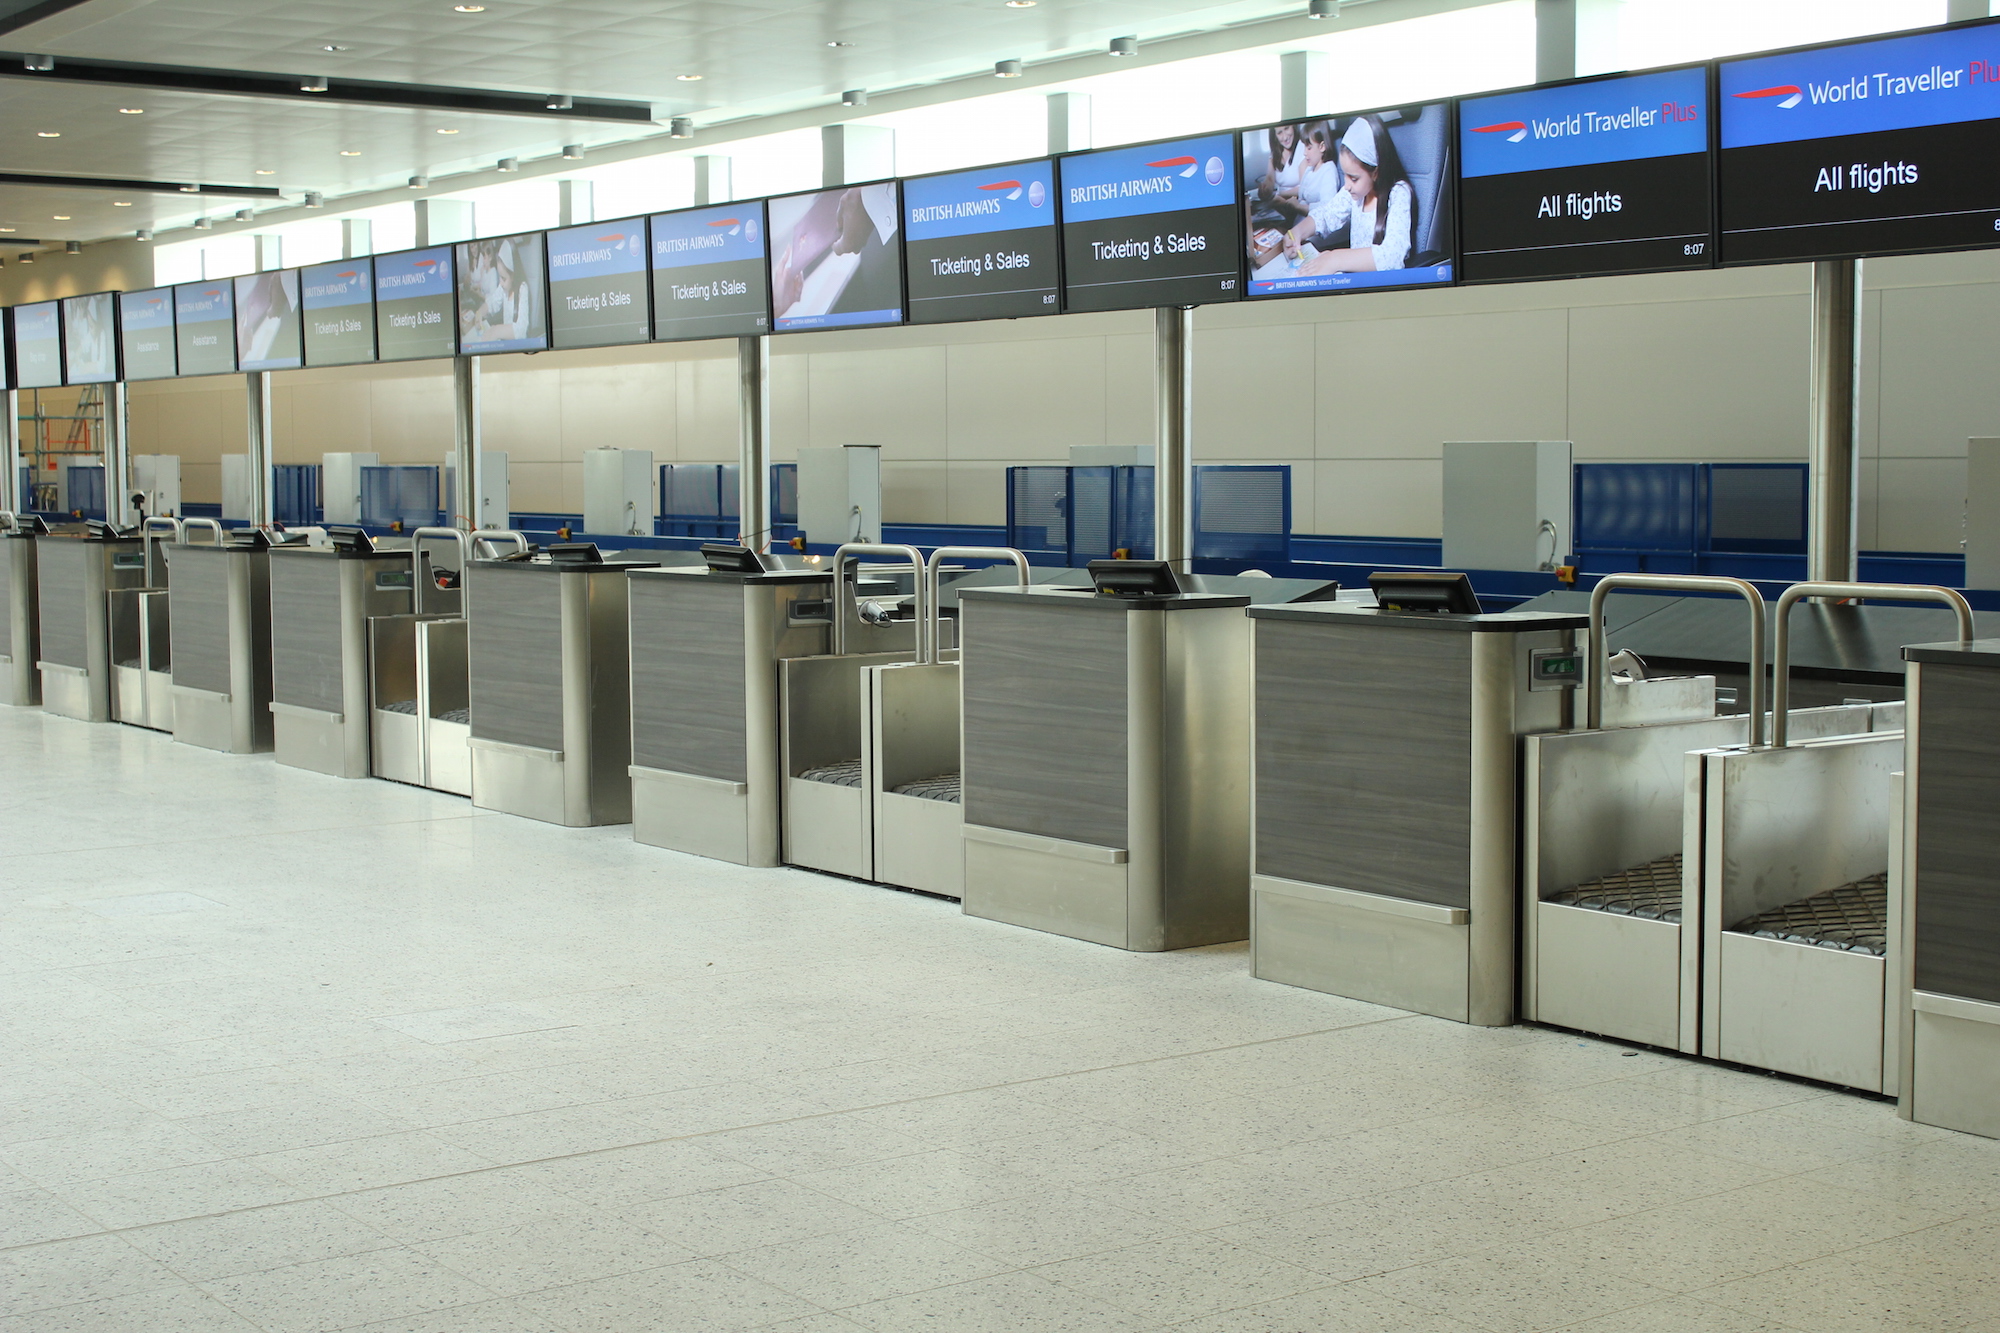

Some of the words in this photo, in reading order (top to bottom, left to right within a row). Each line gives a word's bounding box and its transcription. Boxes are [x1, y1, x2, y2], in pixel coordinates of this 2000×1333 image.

[1808, 74, 1868, 105] World
[1872, 65, 1963, 97] Traveller
[1969, 59, 2000, 85] Plu
[1531, 113, 1581, 140] World
[1583, 106, 1657, 135] Traveller
[1661, 101, 1698, 124] Plus
[1813, 166, 1842, 193] All
[1849, 160, 1919, 194] flights
[1070, 182, 1117, 204] BRITISH
[1119, 175, 1173, 198] AIRWAYS
[912, 203, 953, 223] BRITISH
[954, 198, 1001, 218] AIRWAYS
[1537, 195, 1561, 219] All
[1566, 190, 1622, 221] flights
[657, 237, 688, 254] BRITISH
[689, 233, 724, 250] AIRWAYS
[1091, 238, 1150, 261] Ticketing
[1153, 235, 1164, 255] &
[1167, 232, 1206, 254] Sales
[1683, 243, 1705, 256] 8:07
[553, 252, 581, 267] BRITISH
[581, 248, 612, 264] AIRWAYS
[930, 255, 981, 277] Ticketing
[984, 253, 994, 272] &
[996, 250, 1030, 270] Sales
[304, 284, 325, 298] BRITISH
[325, 281, 348, 295] AIRWAYS
[378, 275, 400, 289] BRITISH
[400, 271, 426, 286] AIRWAYS
[671, 283, 710, 301] Ticketing
[712, 280, 719, 296] &
[721, 279, 747, 295] Sales
[1220, 279, 1236, 290] 8:07
[1275, 281, 1295, 290] BRITISH
[1295, 279, 1317, 288] AIRWAYS
[1318, 278, 1331, 287] World
[566, 294, 600, 312] Ticketing
[601, 292, 608, 307] &
[609, 291, 631, 306] Sales
[1042, 294, 1056, 305] 8:07
[314, 321, 339, 336] Ticketing
[340, 321, 345, 333] &
[345, 319, 362, 332] Sales
[389, 313, 416, 329] Ticketing
[417, 312, 423, 324] &
[423, 310, 441, 324] Sales
[756, 317, 766, 326] 8:07
[192, 335, 218, 346] Assistance
